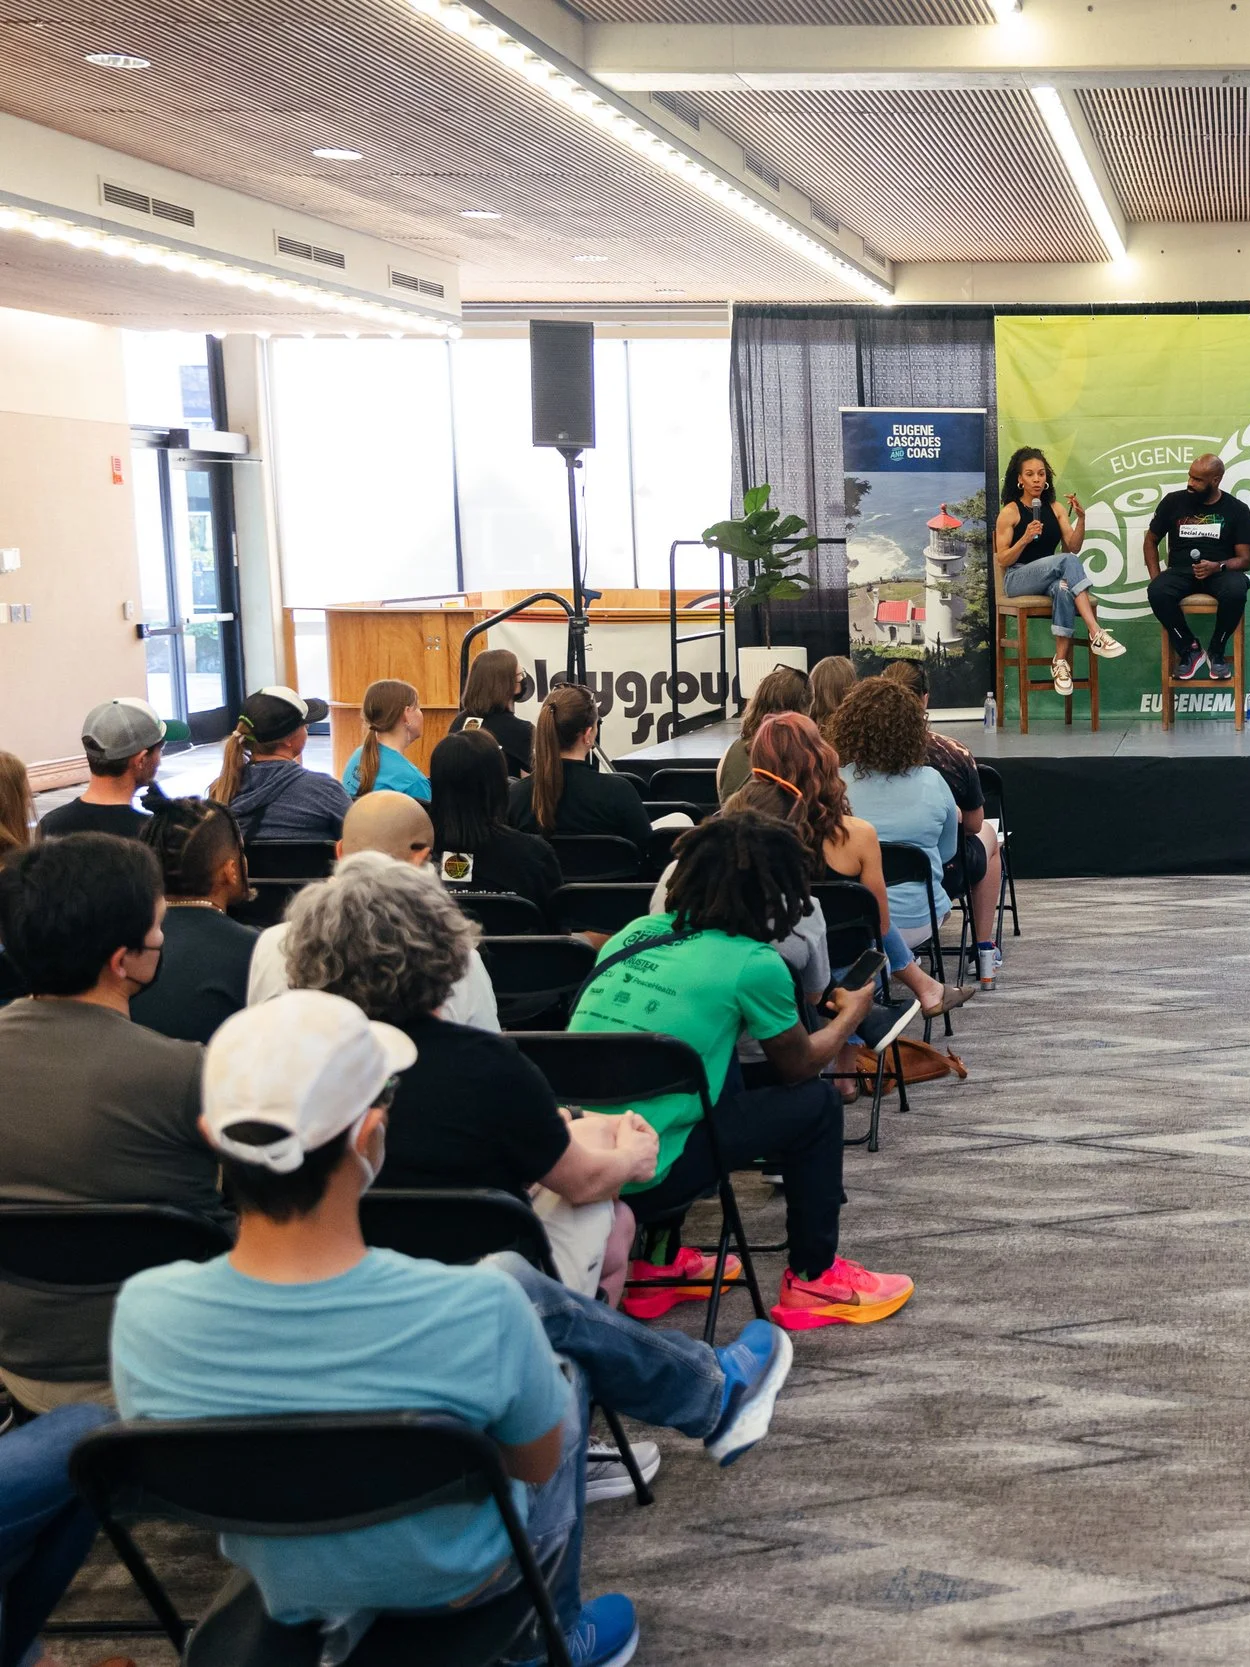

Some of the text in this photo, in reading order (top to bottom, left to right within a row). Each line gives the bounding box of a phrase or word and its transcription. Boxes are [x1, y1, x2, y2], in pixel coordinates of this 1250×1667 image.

[892, 424, 934, 436] EUGENE
[886, 436, 942, 448] CASCADES
[890, 447, 941, 459] AND COAST
[1110, 446, 1194, 474] EUGENE
[632, 977, 677, 997] PeaceHealth
